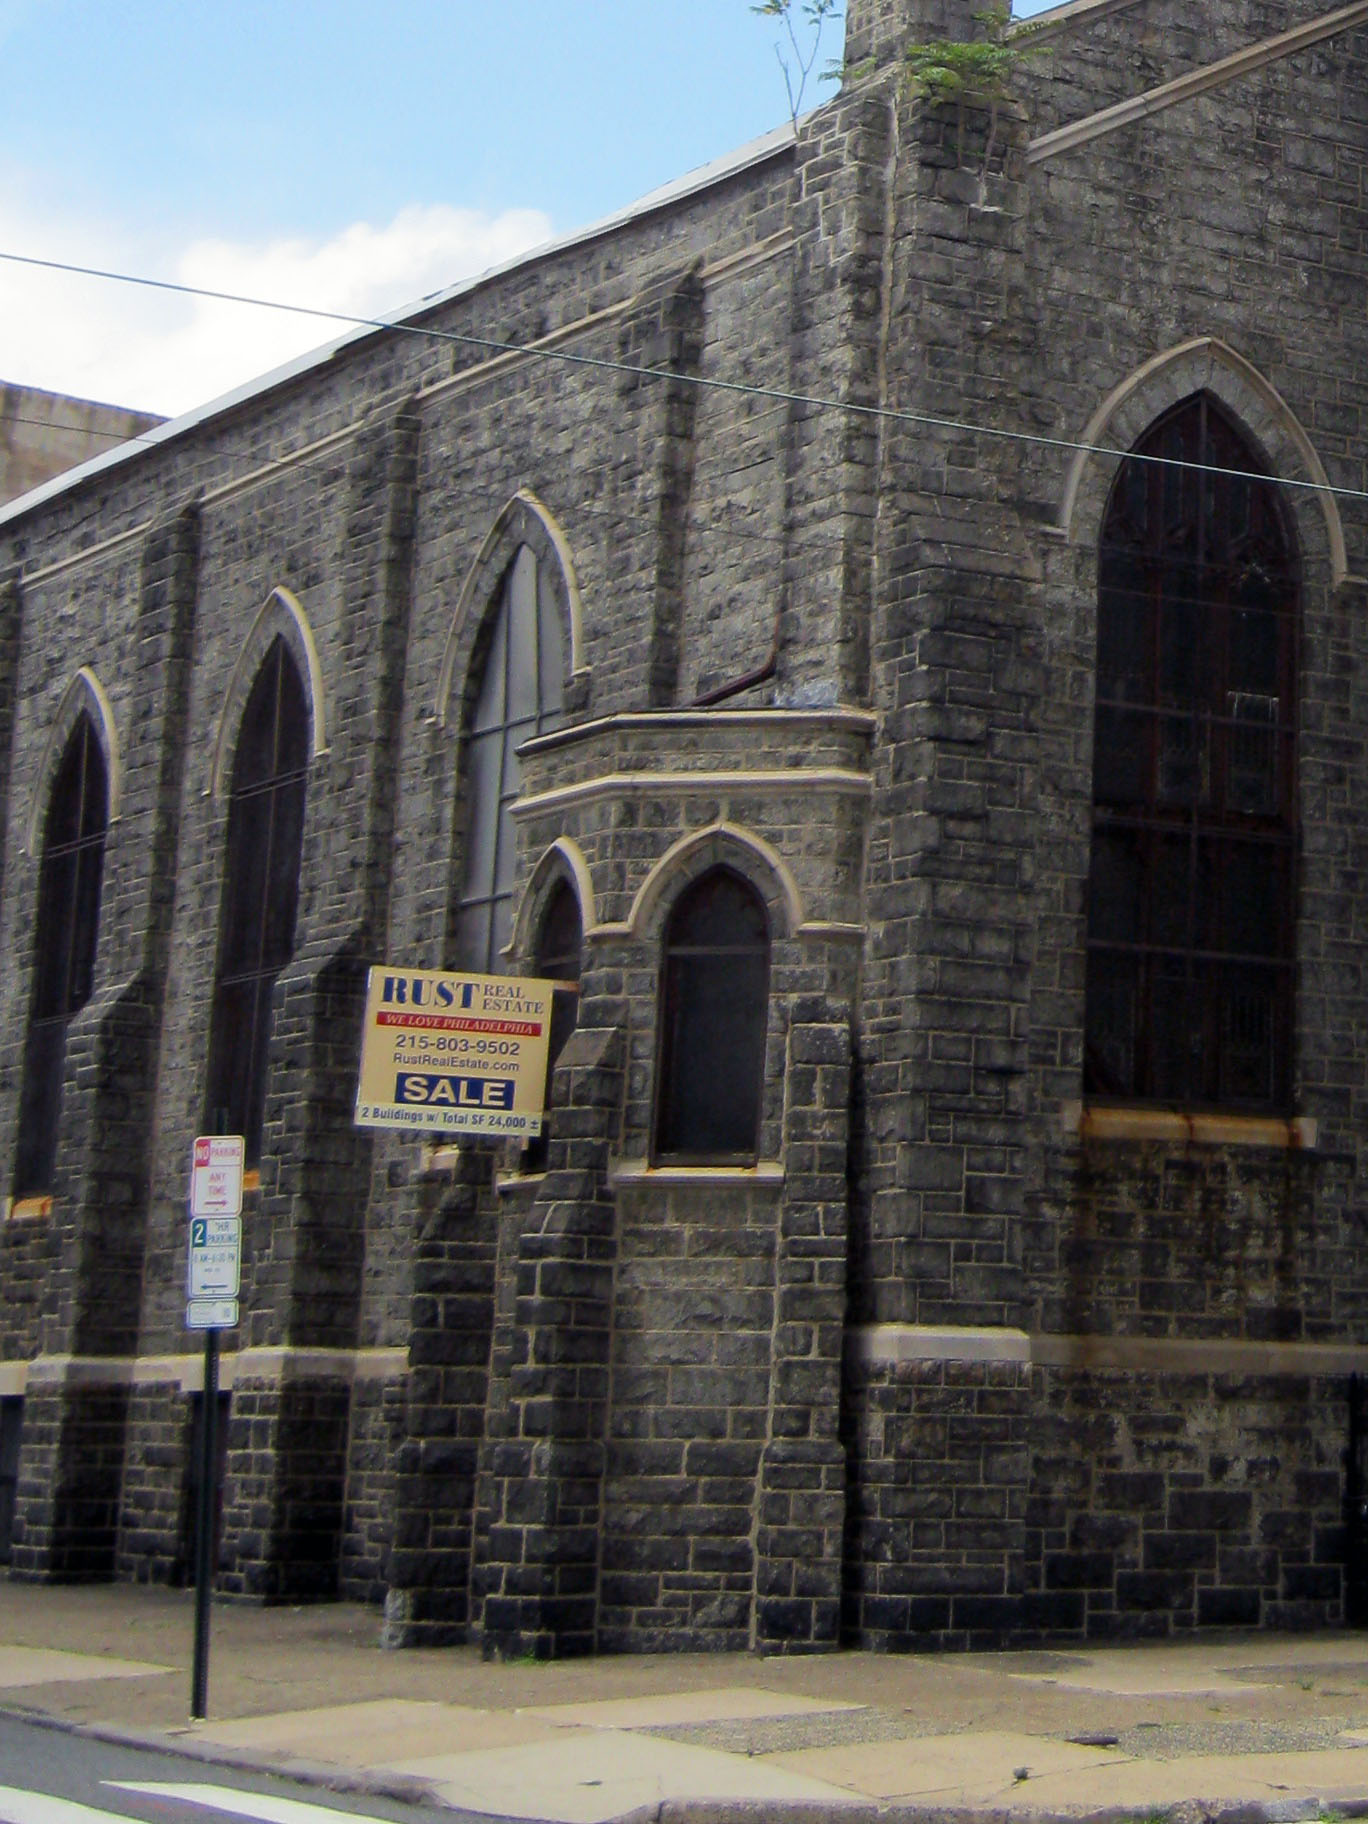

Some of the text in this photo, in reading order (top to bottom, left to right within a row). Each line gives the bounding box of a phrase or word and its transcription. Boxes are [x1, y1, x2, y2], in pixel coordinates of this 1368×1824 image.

[381, 976, 525, 1010] RUST REAL
[483, 998, 544, 1014] ESTATE
[386, 1014, 533, 1034] WE LOVE PHILADELPHIA
[395, 1034, 520, 1056] 215-803-9502
[393, 1052, 519, 1071] RustRealEstate.com
[403, 1076, 506, 1106] SALE
[362, 1107, 369, 1118] 2
[372, 1107, 423, 1122] Buildings
[443, 1112, 468, 1124] Total
[471, 1115, 485, 1126] SF
[488, 1115, 526, 1129] 24,000
[196, 1145, 240, 1161] NO PARKING
[208, 1171, 226, 1183] ANY
[208, 1184, 227, 1196] TIME
[194, 1223, 204, 1244] 2
